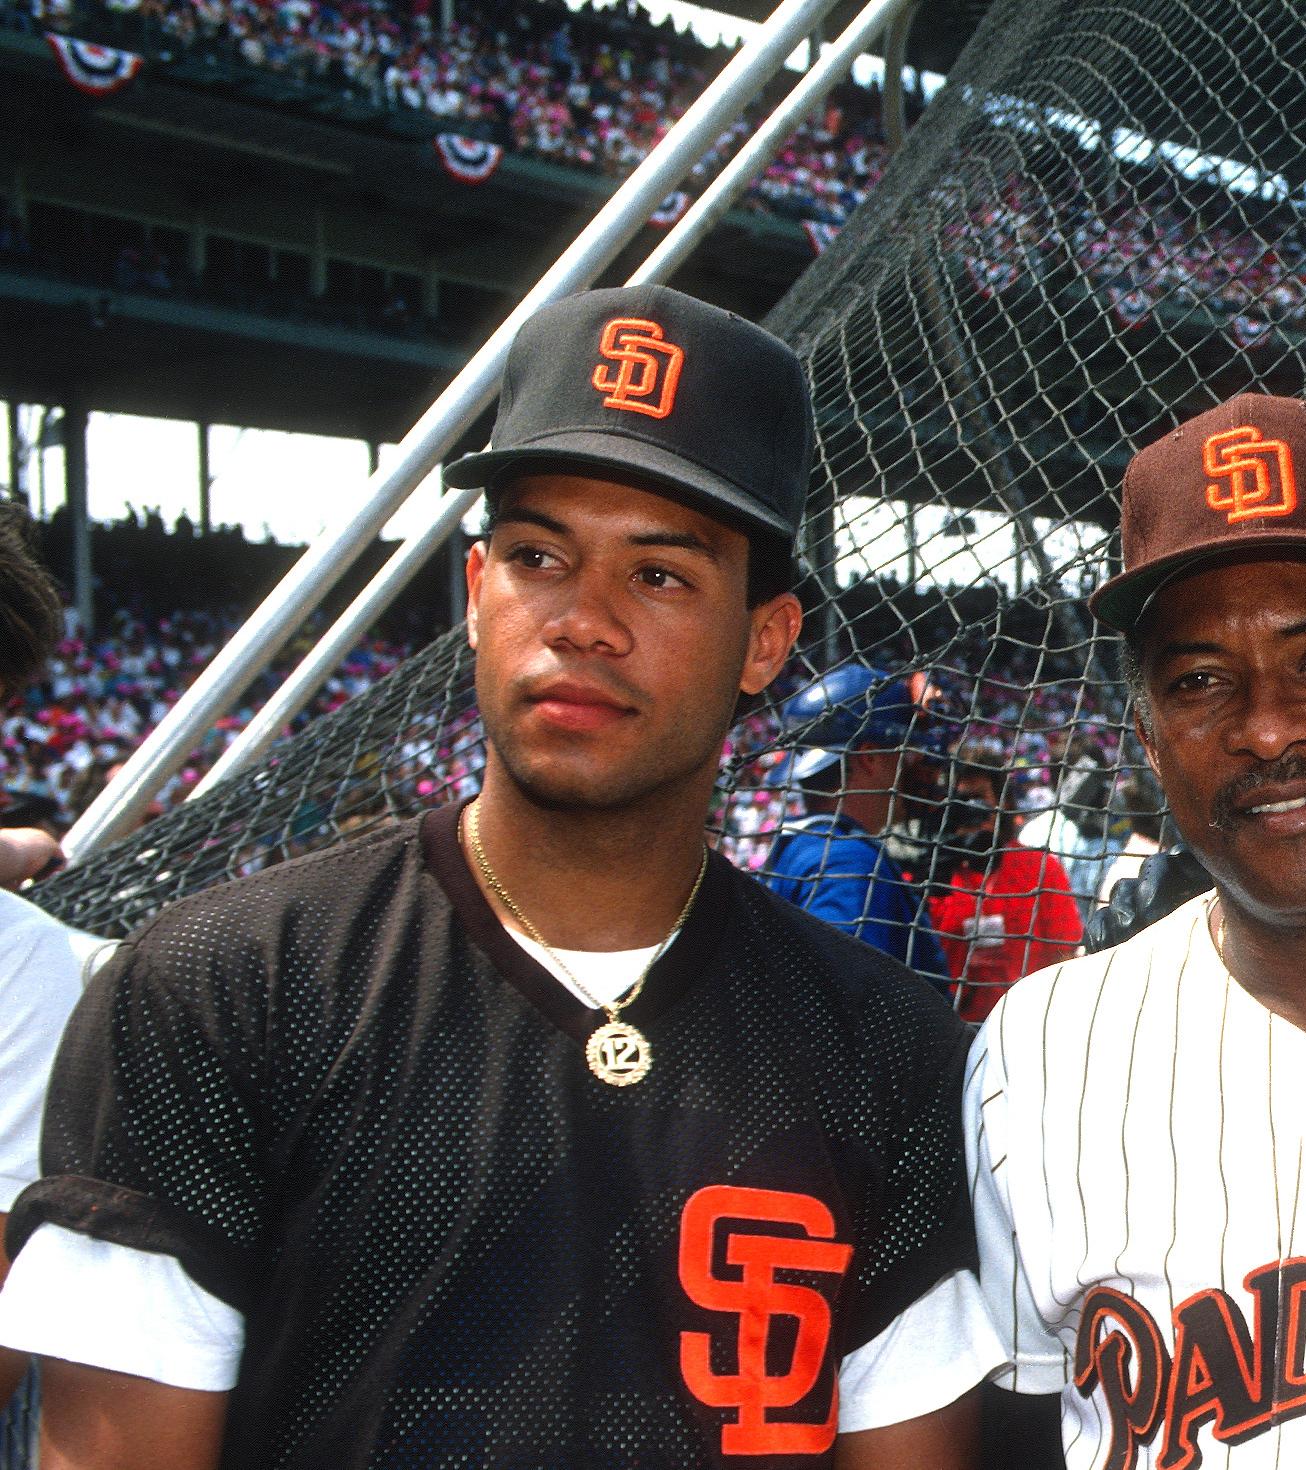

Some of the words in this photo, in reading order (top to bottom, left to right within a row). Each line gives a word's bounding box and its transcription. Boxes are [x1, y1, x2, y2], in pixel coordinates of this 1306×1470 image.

[591, 317, 685, 419] SD
[1202, 425, 1297, 525] SD
[600, 1037, 640, 1070] 12
